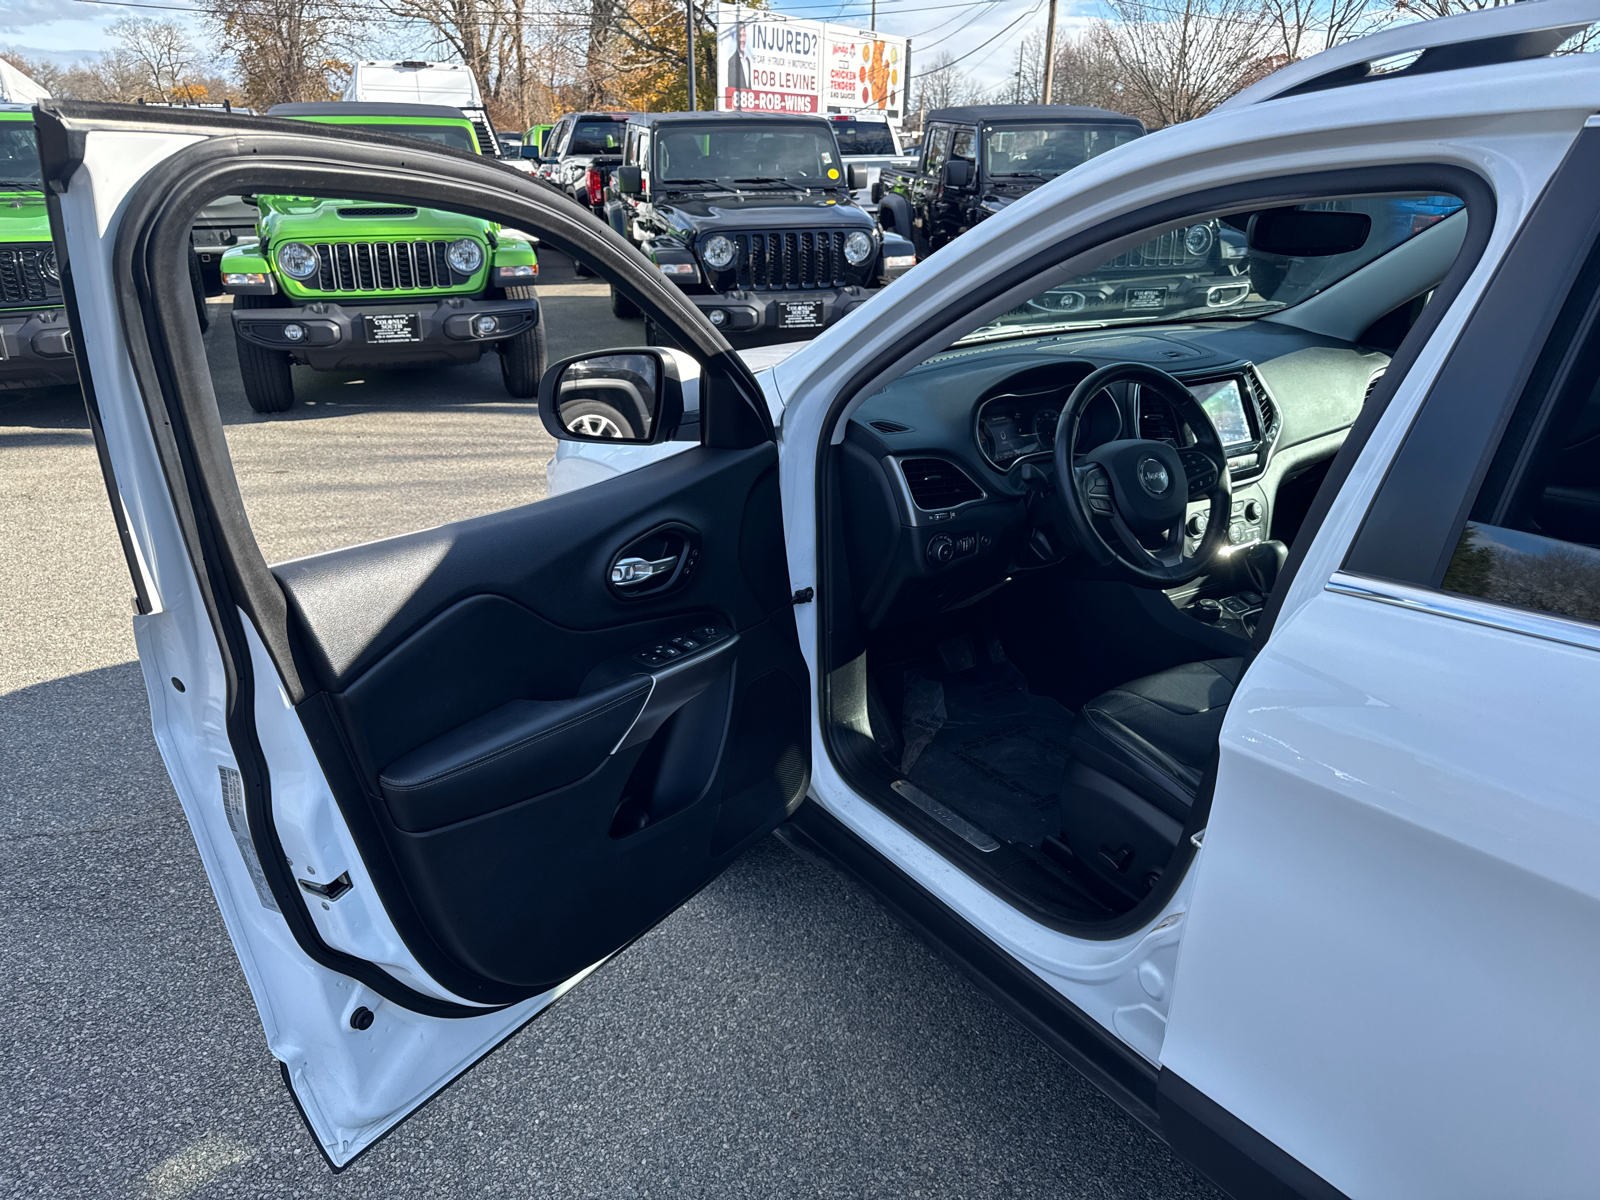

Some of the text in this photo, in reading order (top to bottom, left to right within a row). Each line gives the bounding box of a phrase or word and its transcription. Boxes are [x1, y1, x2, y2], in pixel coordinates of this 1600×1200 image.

[752, 24, 818, 57] INJURED?
[753, 69, 816, 91] ROB LEVINE
[830, 69, 857, 80] CHICKEN
[830, 80, 856, 91] TENDERS
[1145, 472, 1166, 480] Jeep
[989, 768, 1010, 780] MUST
[1010, 780, 1040, 799] REMOVE
[994, 778, 1018, 792] COVER
